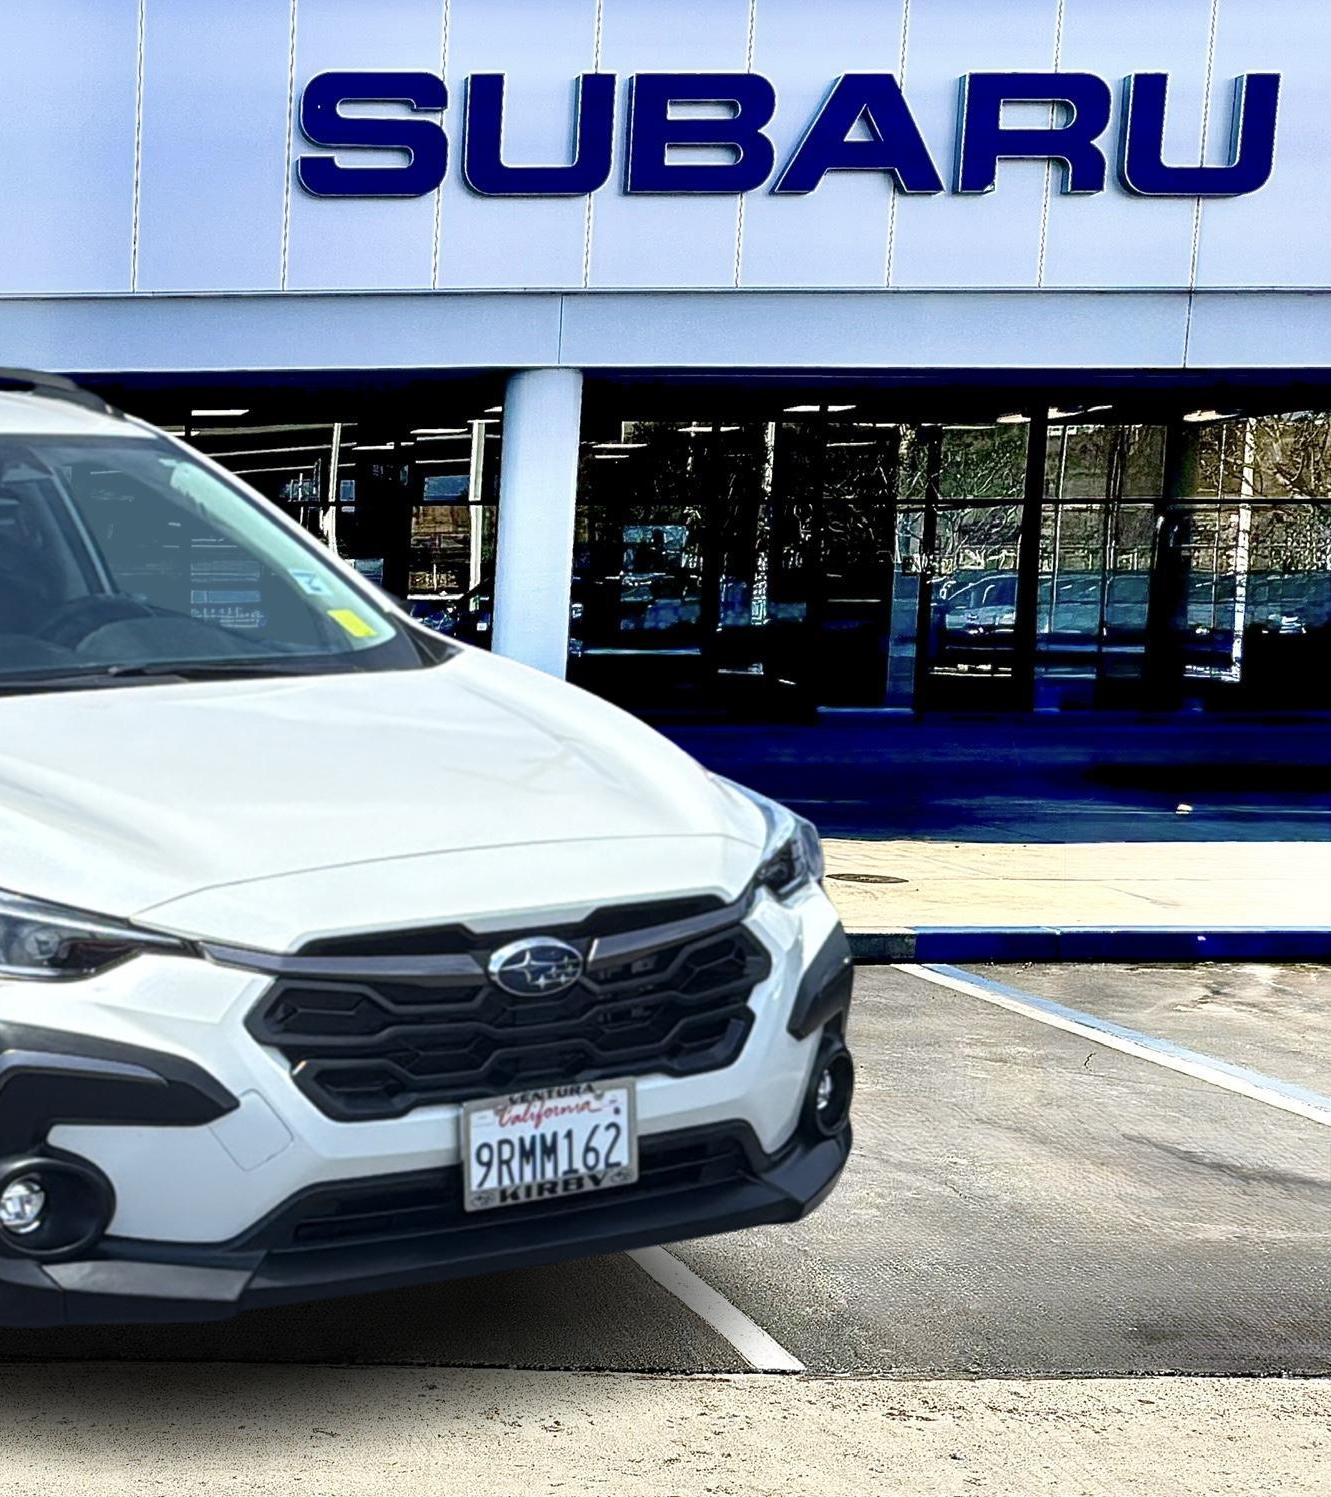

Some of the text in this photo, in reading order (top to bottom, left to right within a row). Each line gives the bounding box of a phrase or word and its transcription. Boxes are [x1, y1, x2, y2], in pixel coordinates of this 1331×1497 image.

[297, 70, 1282, 198] SUBARU
[508, 1082, 595, 1105] VENTURA
[498, 1099, 602, 1130] California
[475, 1121, 622, 1189] 9RMM162
[499, 1172, 607, 1203] KIRBY
